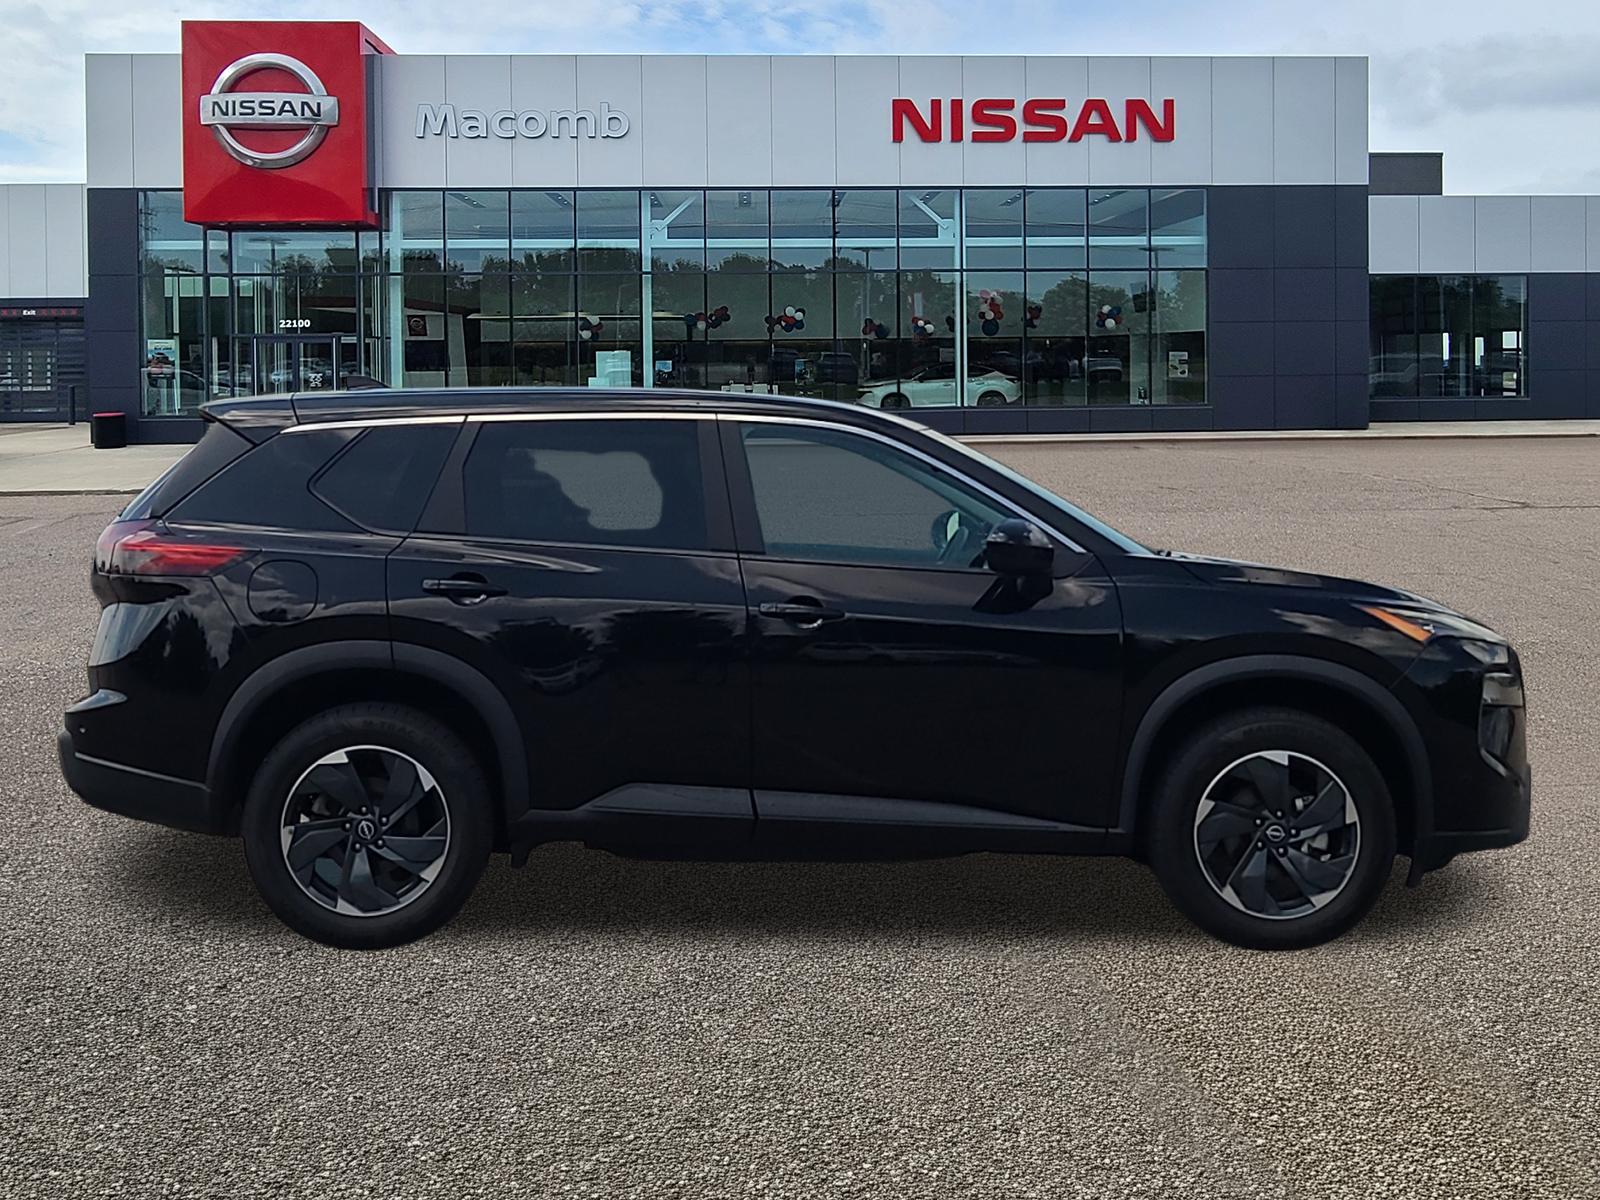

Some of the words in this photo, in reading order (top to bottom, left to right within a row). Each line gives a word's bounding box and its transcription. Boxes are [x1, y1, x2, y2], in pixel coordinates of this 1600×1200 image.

[211, 100, 322, 117] NISSAN
[415, 102, 630, 138] Macomb
[892, 98, 1175, 142] NISSAN
[279, 319, 311, 327] 22100
